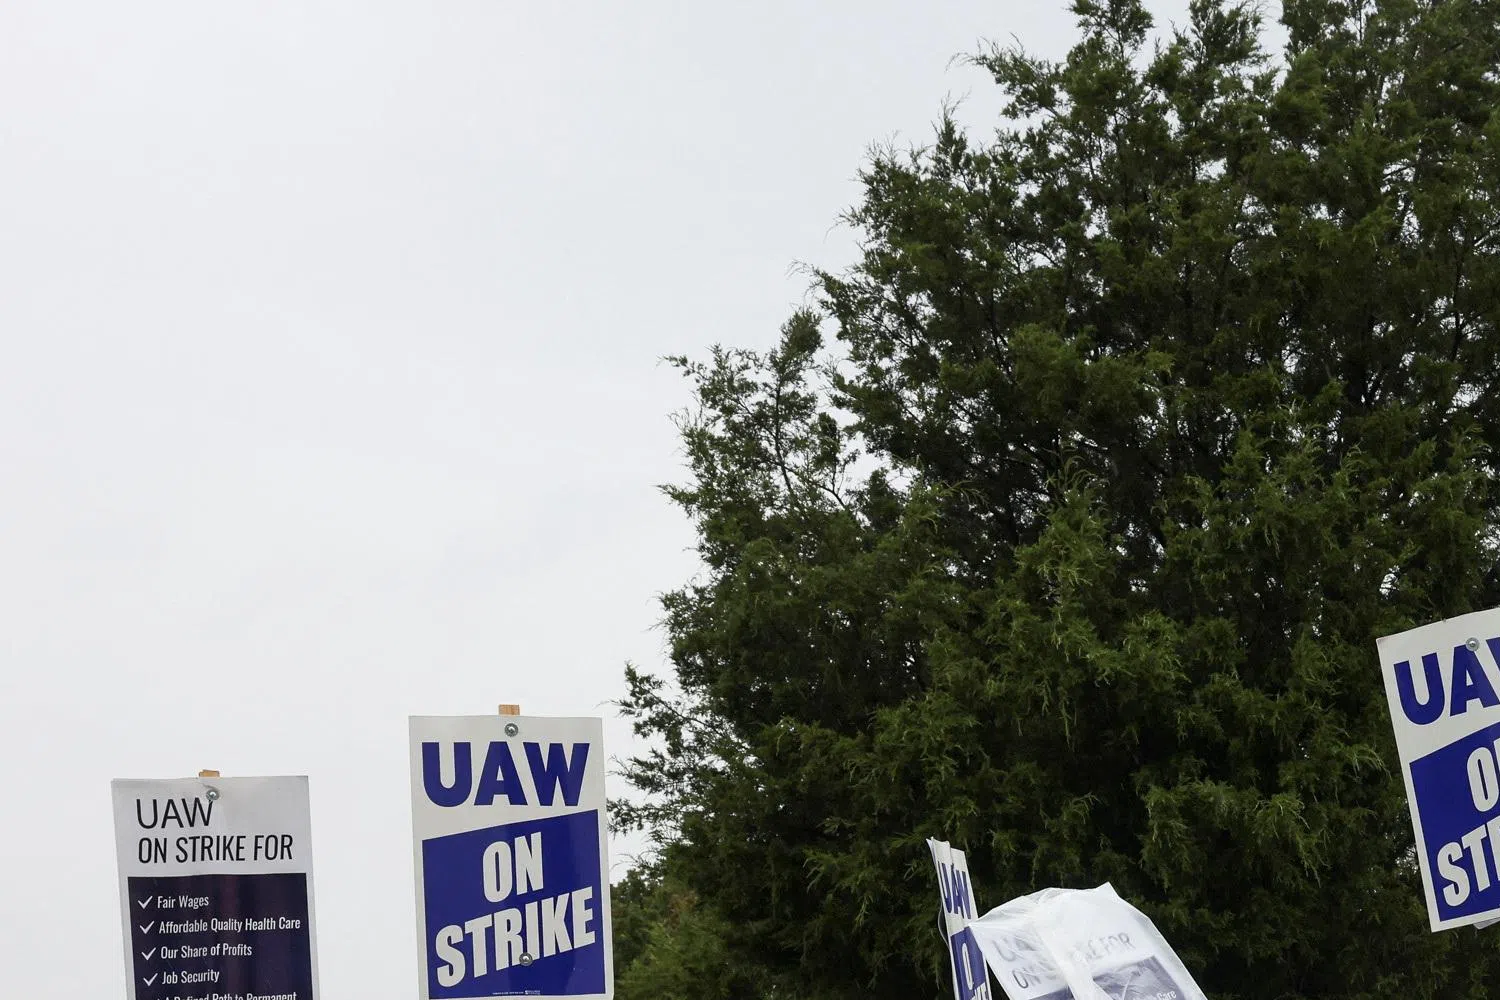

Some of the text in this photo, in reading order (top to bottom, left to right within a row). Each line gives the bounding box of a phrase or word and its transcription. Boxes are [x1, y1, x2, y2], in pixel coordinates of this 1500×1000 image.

[421, 741, 591, 808] UAW
[136, 797, 213, 829] UAW
[138, 834, 293, 863] ON STRIKE FOR
[482, 831, 544, 903] ON
[157, 894, 209, 909] Fair Wages
[159, 916, 301, 934] Affordable Quality Health Care
[435, 886, 596, 988] STRIKE
[160, 943, 253, 959] Our Share of Profits
[162, 968, 220, 985] Job Security
